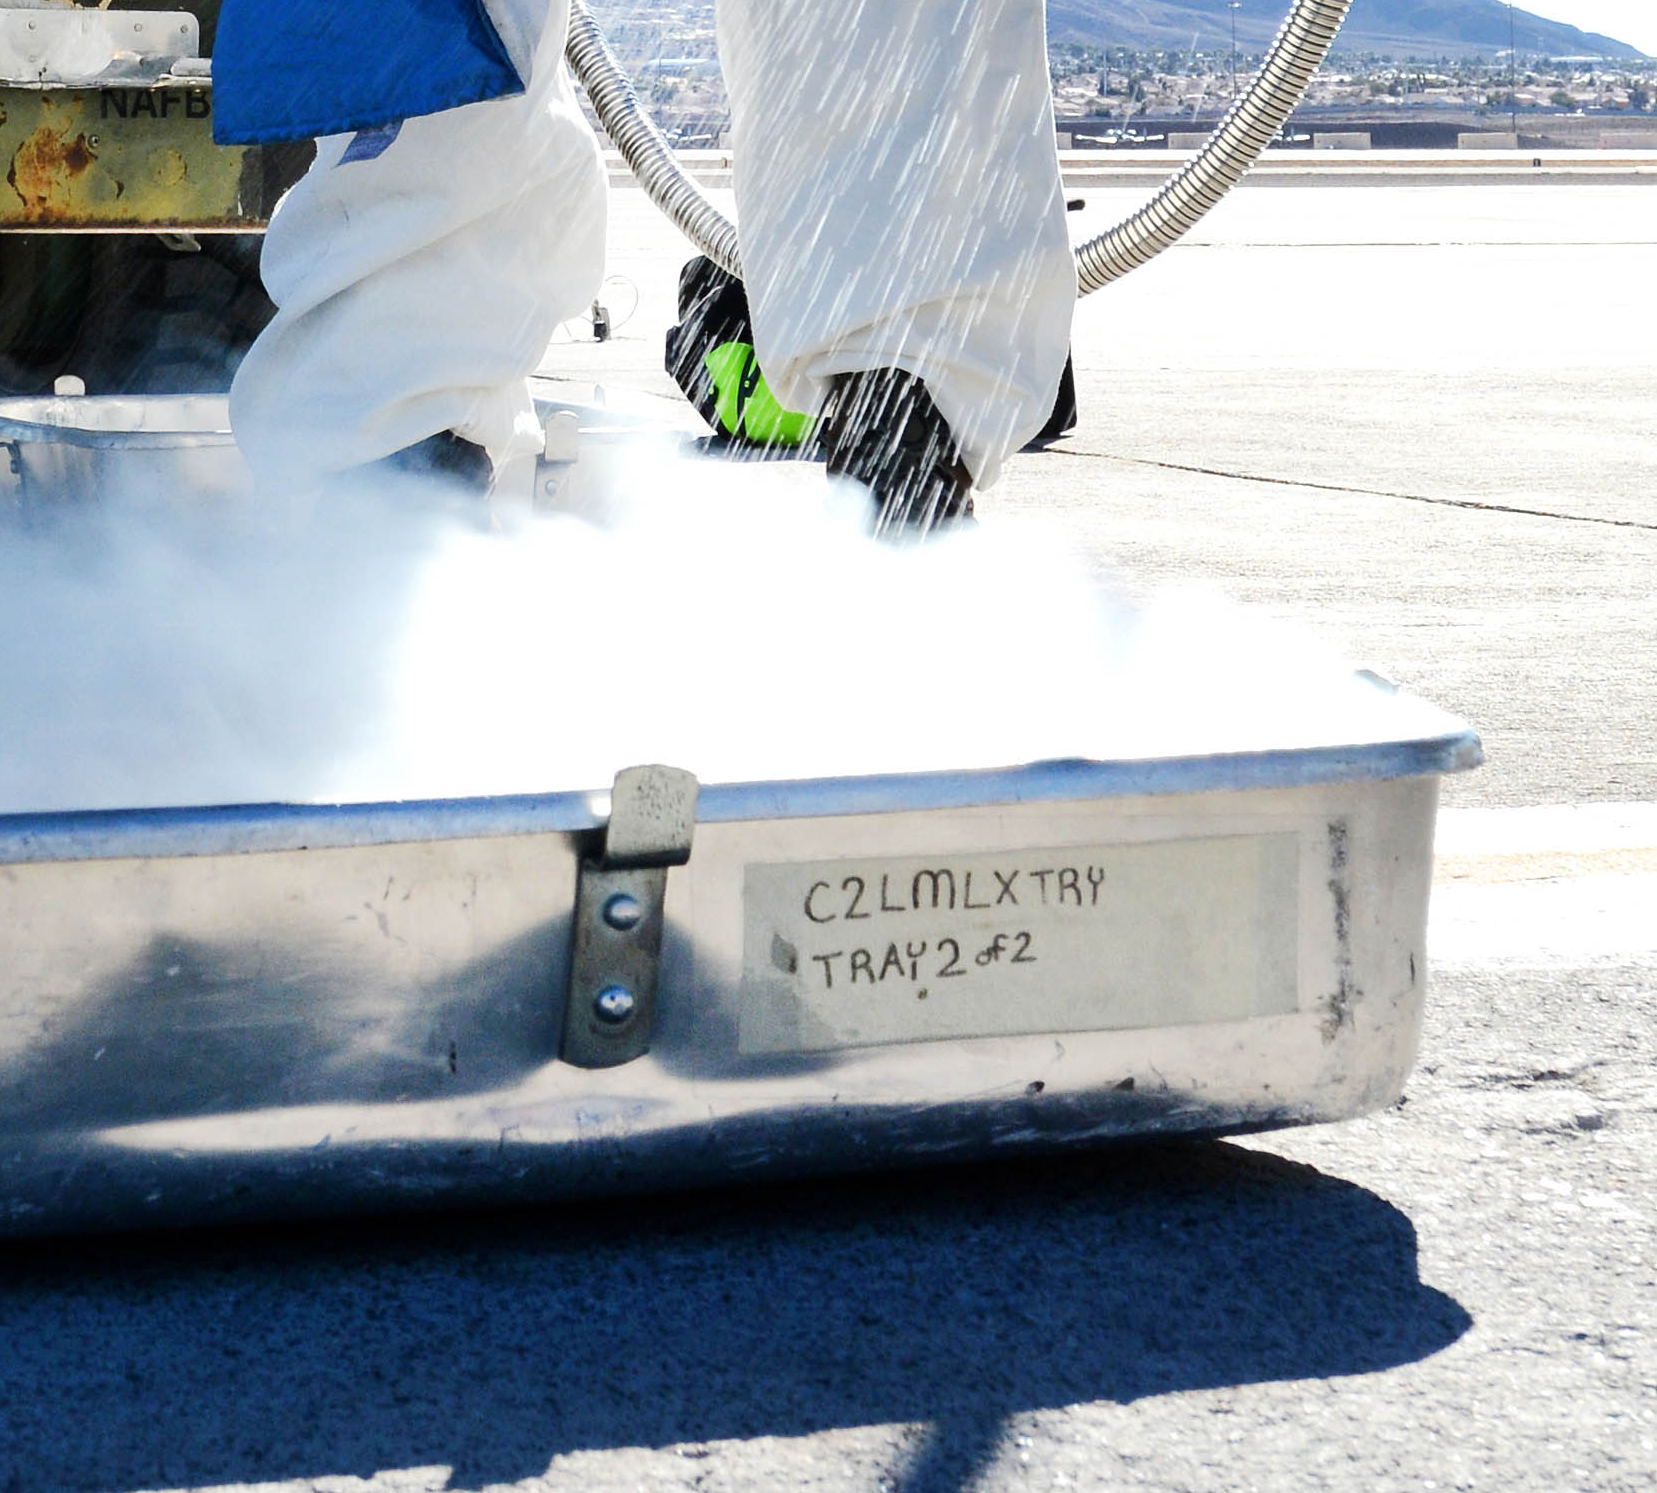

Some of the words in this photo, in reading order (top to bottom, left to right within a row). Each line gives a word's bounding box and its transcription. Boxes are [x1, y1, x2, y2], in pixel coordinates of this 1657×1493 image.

[99, 87, 211, 118] NAFB
[812, 940, 927, 989] TRAY
[936, 937, 967, 978] 2
